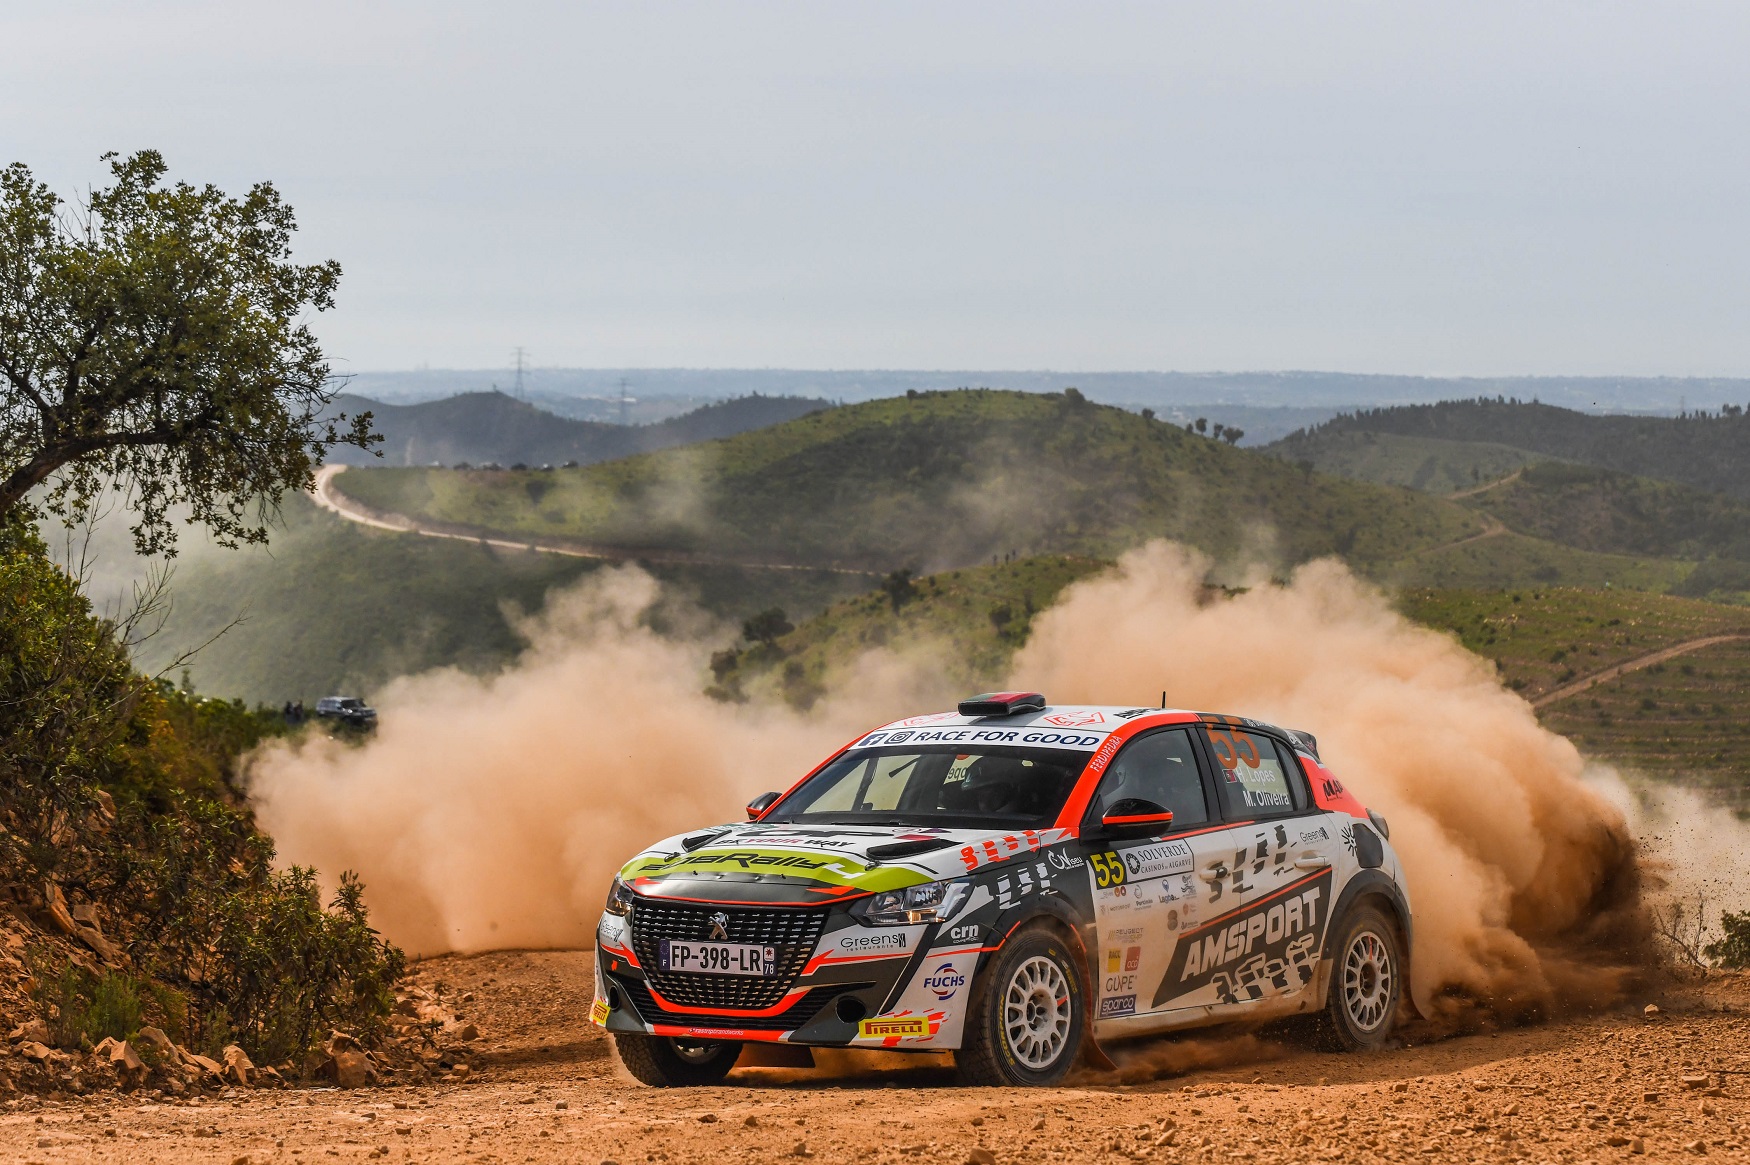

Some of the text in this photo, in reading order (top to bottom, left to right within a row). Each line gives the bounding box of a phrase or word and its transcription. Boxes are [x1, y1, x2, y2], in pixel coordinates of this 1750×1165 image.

[913, 730, 1100, 746] RACE FOR GOOD
[1201, 716, 1261, 769] 55
[1236, 768, 1276, 786] H. Lopes
[1242, 789, 1290, 807] M. Oliveira
[1138, 844, 1188, 862] SOLVERDE
[1090, 851, 1125, 887] 55
[1140, 863, 1165, 874] CASINOS
[1168, 858, 1192, 869] ALGARVE
[950, 924, 979, 939] crn
[1180, 886, 1321, 982] AMSPORT
[840, 934, 899, 948] Greens
[846, 944, 894, 952] restaurante
[662, 958, 667, 967] F
[671, 945, 762, 972] FP-398-LR
[764, 963, 775, 975] 78
[923, 975, 965, 988] FUCHS
[1102, 997, 1134, 1012] sparco
[865, 1020, 923, 1035] PIRELLI
